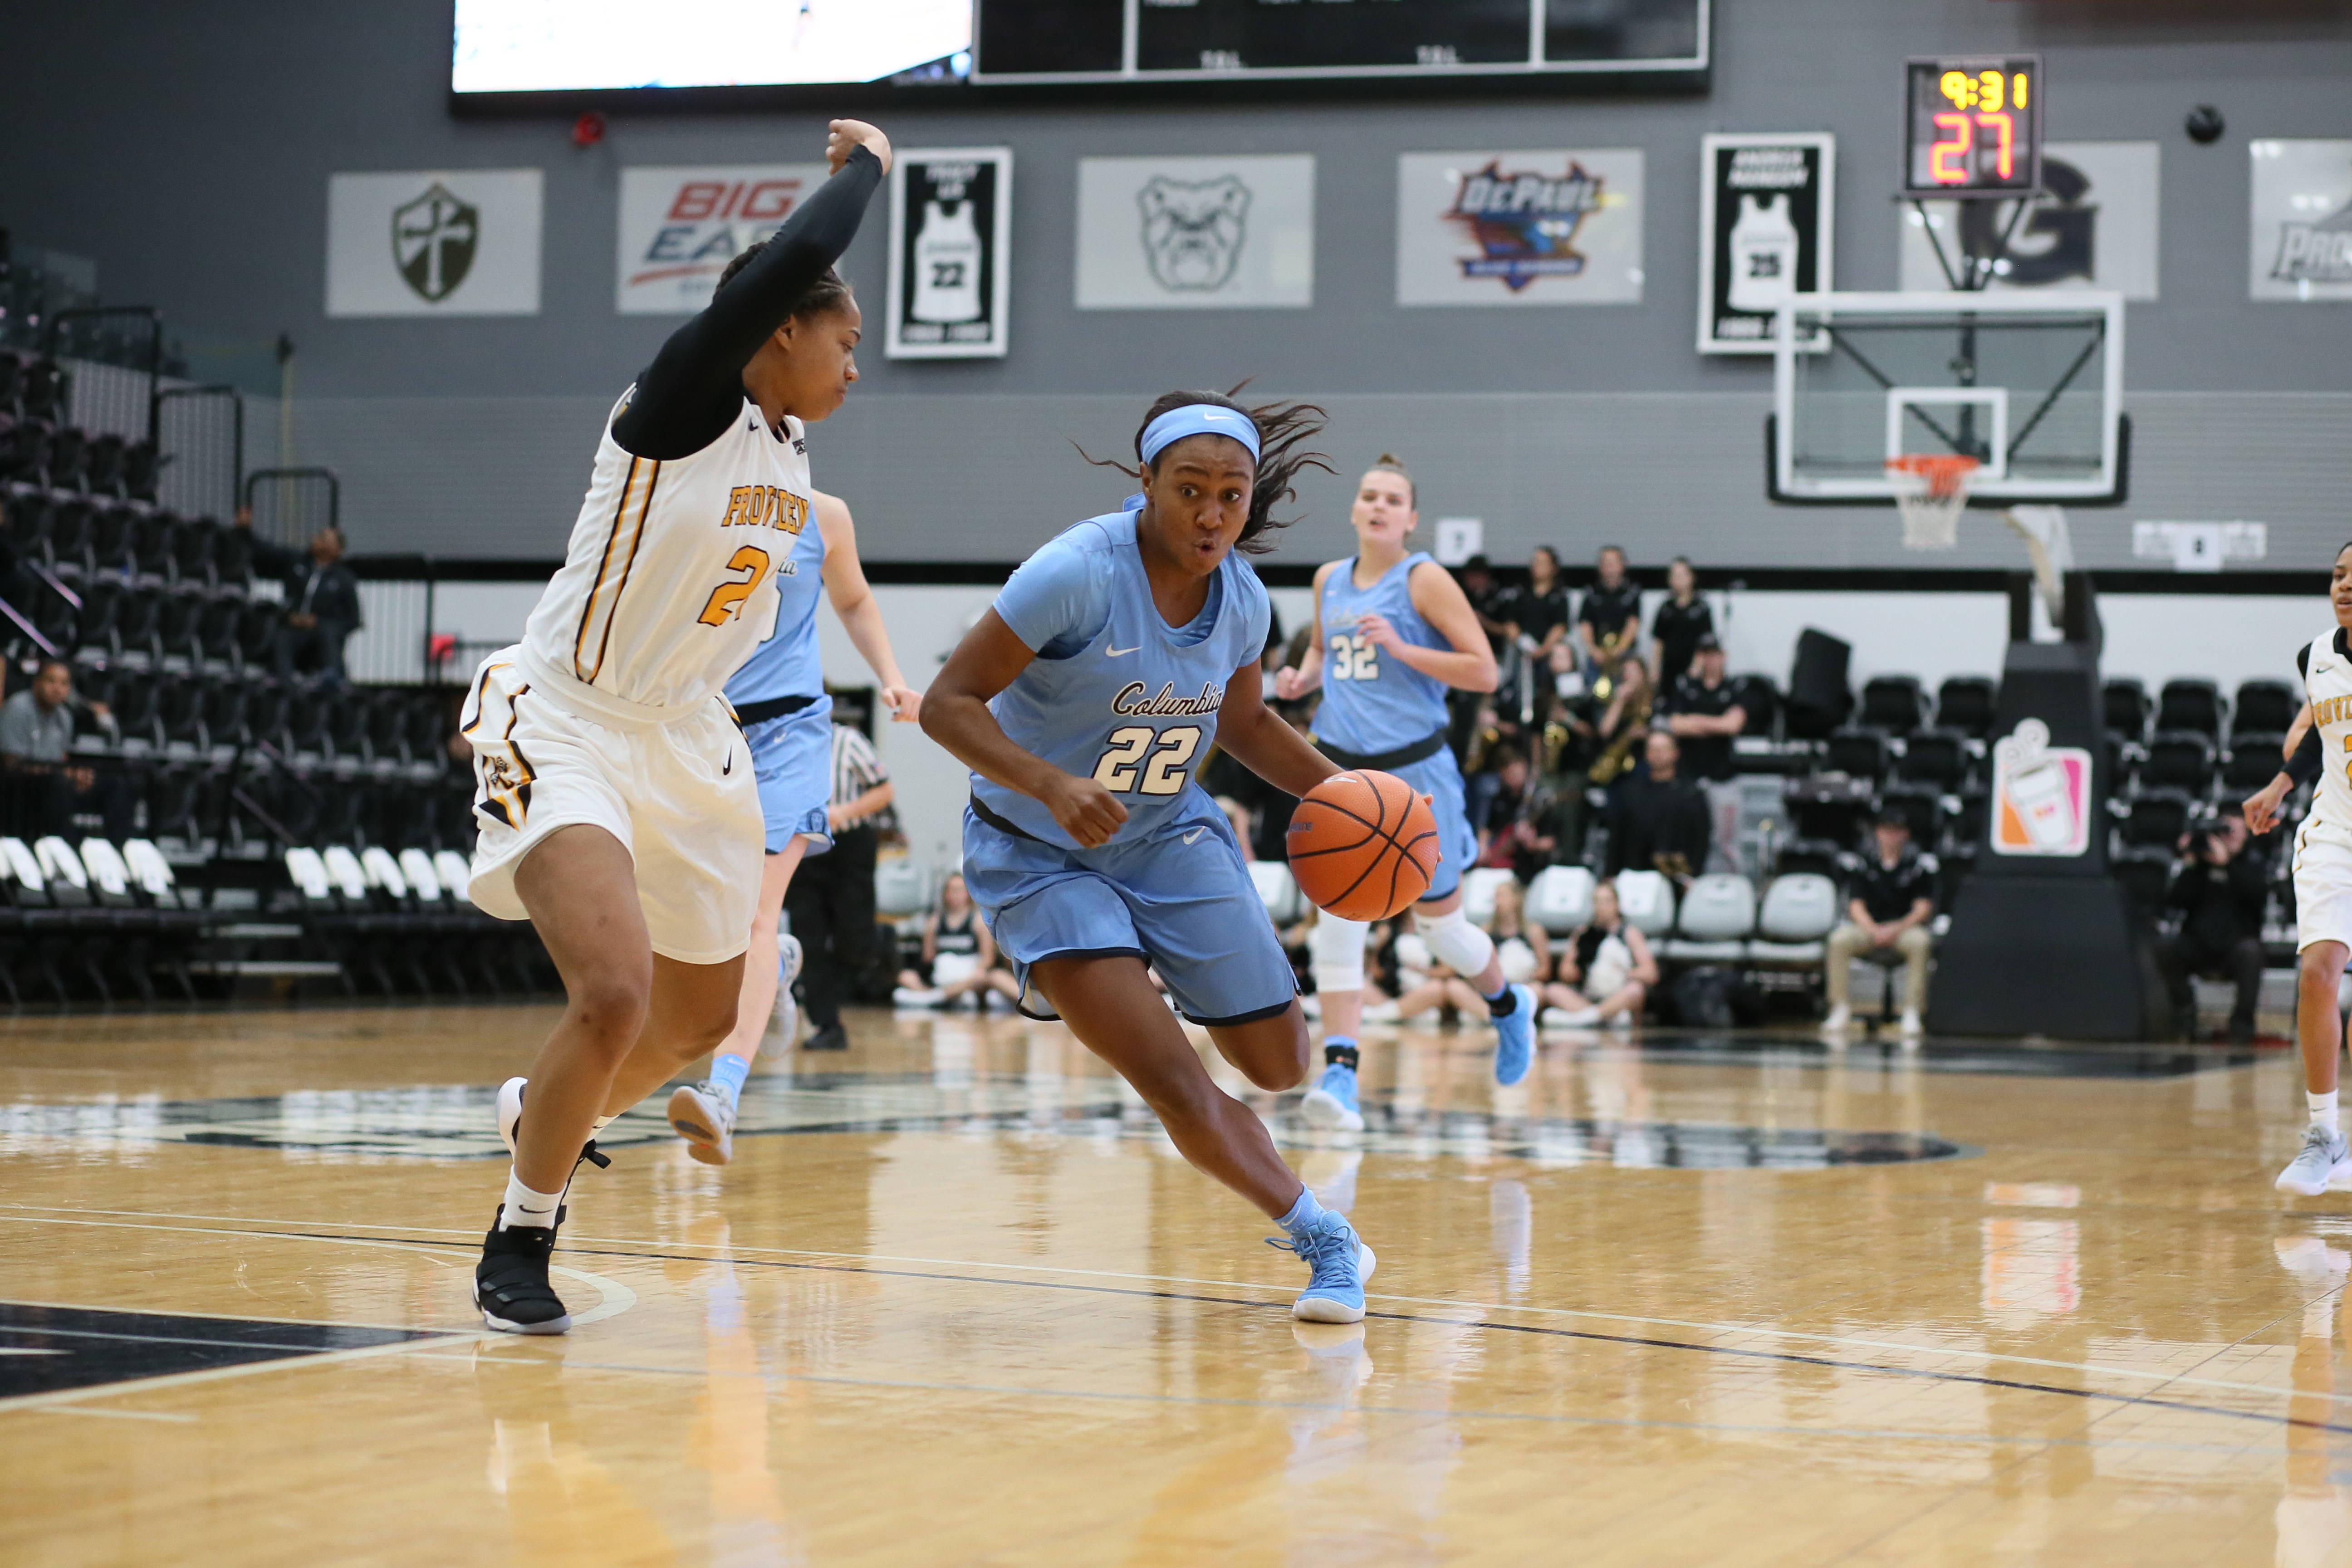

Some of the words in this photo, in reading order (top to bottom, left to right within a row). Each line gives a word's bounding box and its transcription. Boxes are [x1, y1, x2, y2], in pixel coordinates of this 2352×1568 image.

[1940, 71, 2028, 112] 9:31
[1929, 113, 2014, 183] 27
[667, 179, 802, 220] BIG
[932, 262, 965, 288] 22
[697, 545, 769, 627] 2
[1331, 635, 1379, 680] 32
[1112, 681, 1223, 717] Columbia
[1091, 725, 1202, 796] 22
